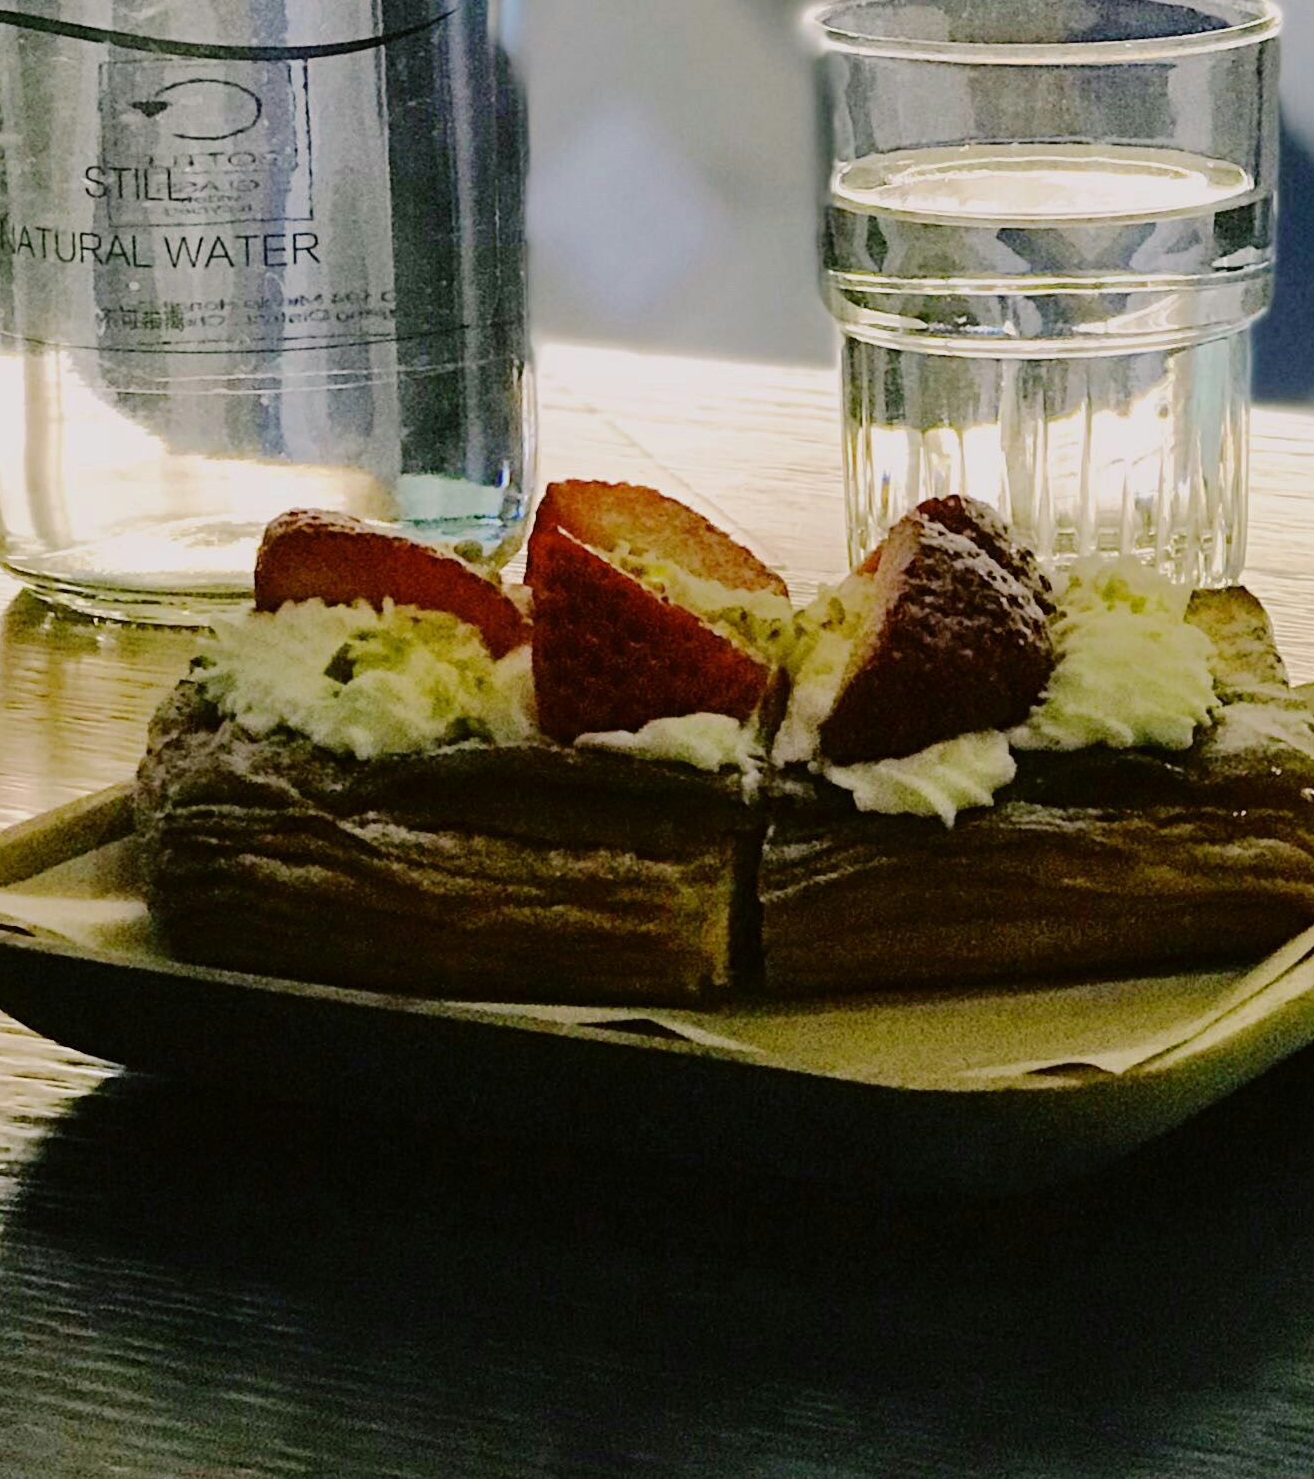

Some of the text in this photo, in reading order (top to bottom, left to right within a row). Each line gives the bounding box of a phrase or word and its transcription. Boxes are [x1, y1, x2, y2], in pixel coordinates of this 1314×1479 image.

[84, 164, 190, 203] STILL
[0, 214, 321, 268] NATURAL WATER
